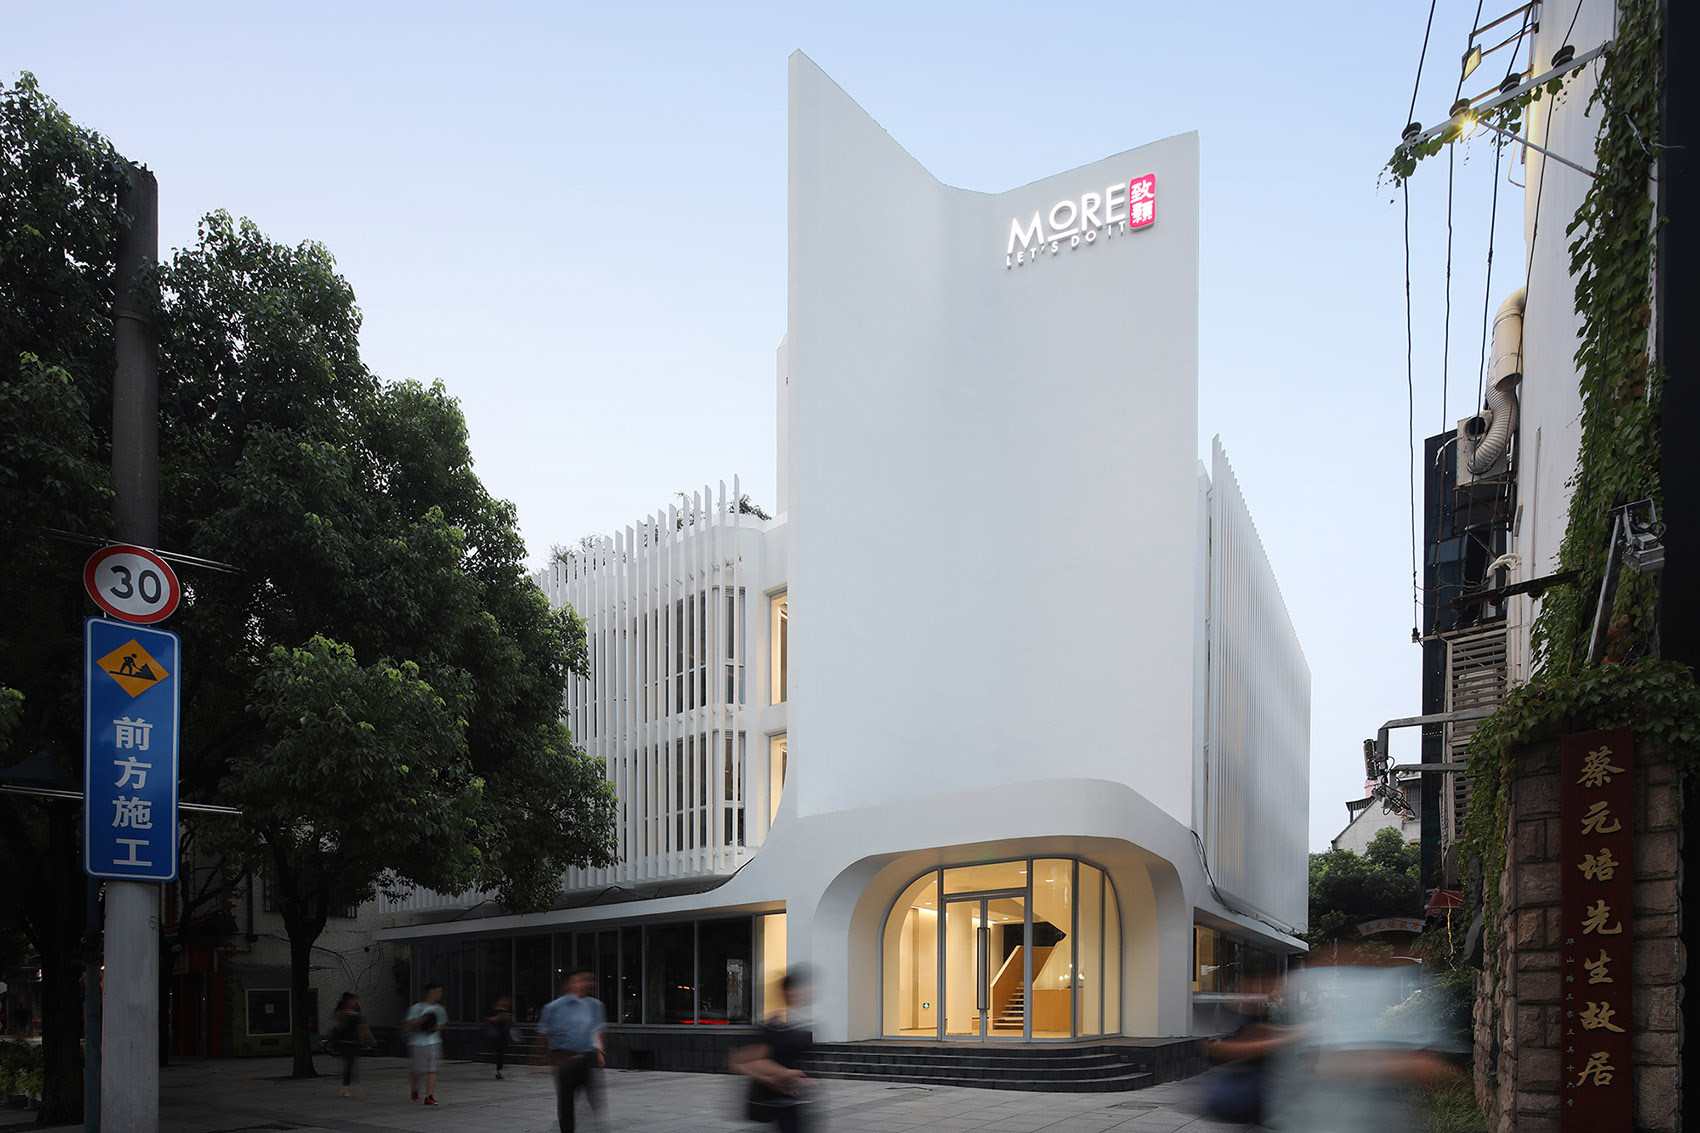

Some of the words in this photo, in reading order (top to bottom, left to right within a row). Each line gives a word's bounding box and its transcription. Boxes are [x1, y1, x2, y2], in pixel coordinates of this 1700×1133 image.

[1007, 182, 1126, 254] MORE
[1071, 230, 1097, 248] DO
[1108, 220, 1126, 236] IT
[109, 565, 162, 604] 30
[112, 716, 153, 867] 前方施工
[1576, 745, 1626, 1087] 蔡元培先生故居
